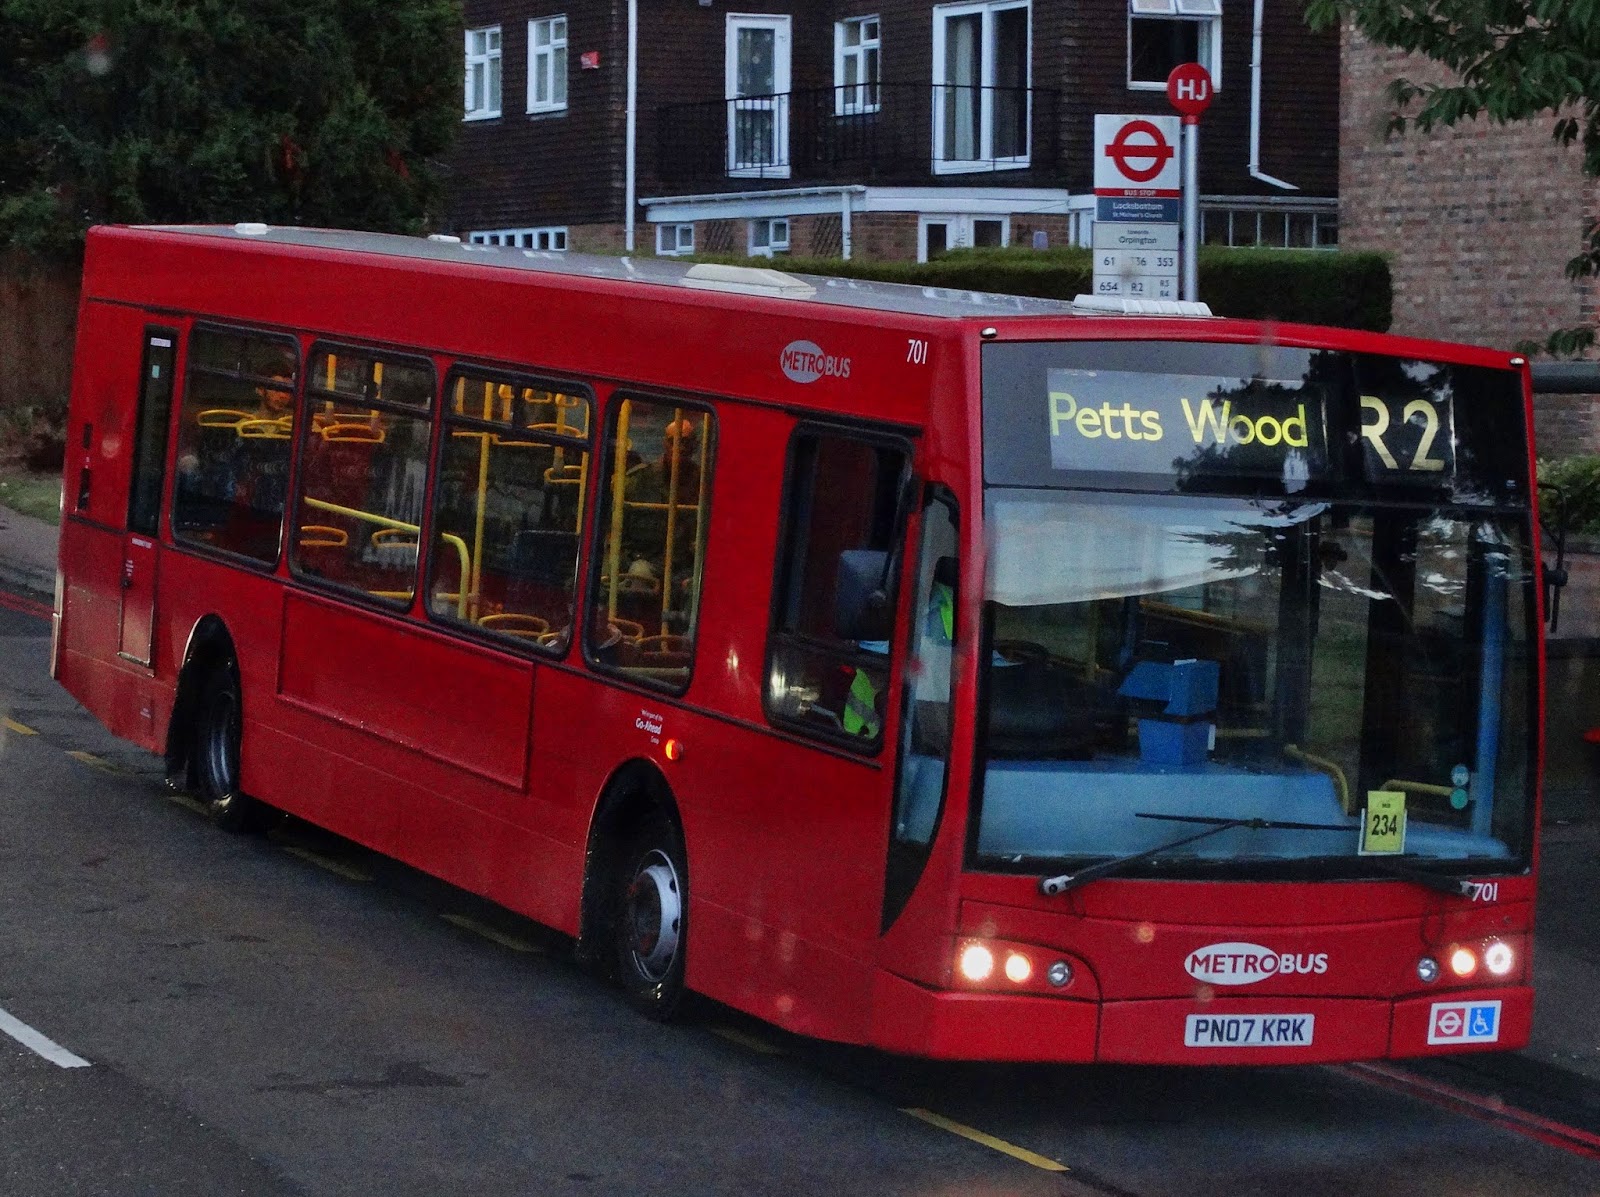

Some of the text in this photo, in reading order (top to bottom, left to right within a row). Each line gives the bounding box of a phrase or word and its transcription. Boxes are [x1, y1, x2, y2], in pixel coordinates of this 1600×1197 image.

[1177, 79, 1207, 101] HJ
[1119, 236, 1157, 245] Orpington
[1103, 257, 1115, 266] 61
[1129, 256, 1147, 266] 36
[1157, 257, 1174, 267] 353
[1100, 282, 1118, 291] 654
[1131, 282, 1143, 292] R2
[906, 339, 928, 365] 701
[782, 350, 851, 378] METROBUS
[1048, 391, 1309, 448] Petts Wood
[1359, 395, 1446, 472] R2
[1371, 814, 1397, 836] 234
[1472, 882, 1498, 901] 701
[1190, 953, 1329, 974] METROBUS
[1194, 1018, 1306, 1043] PN07 KRK
